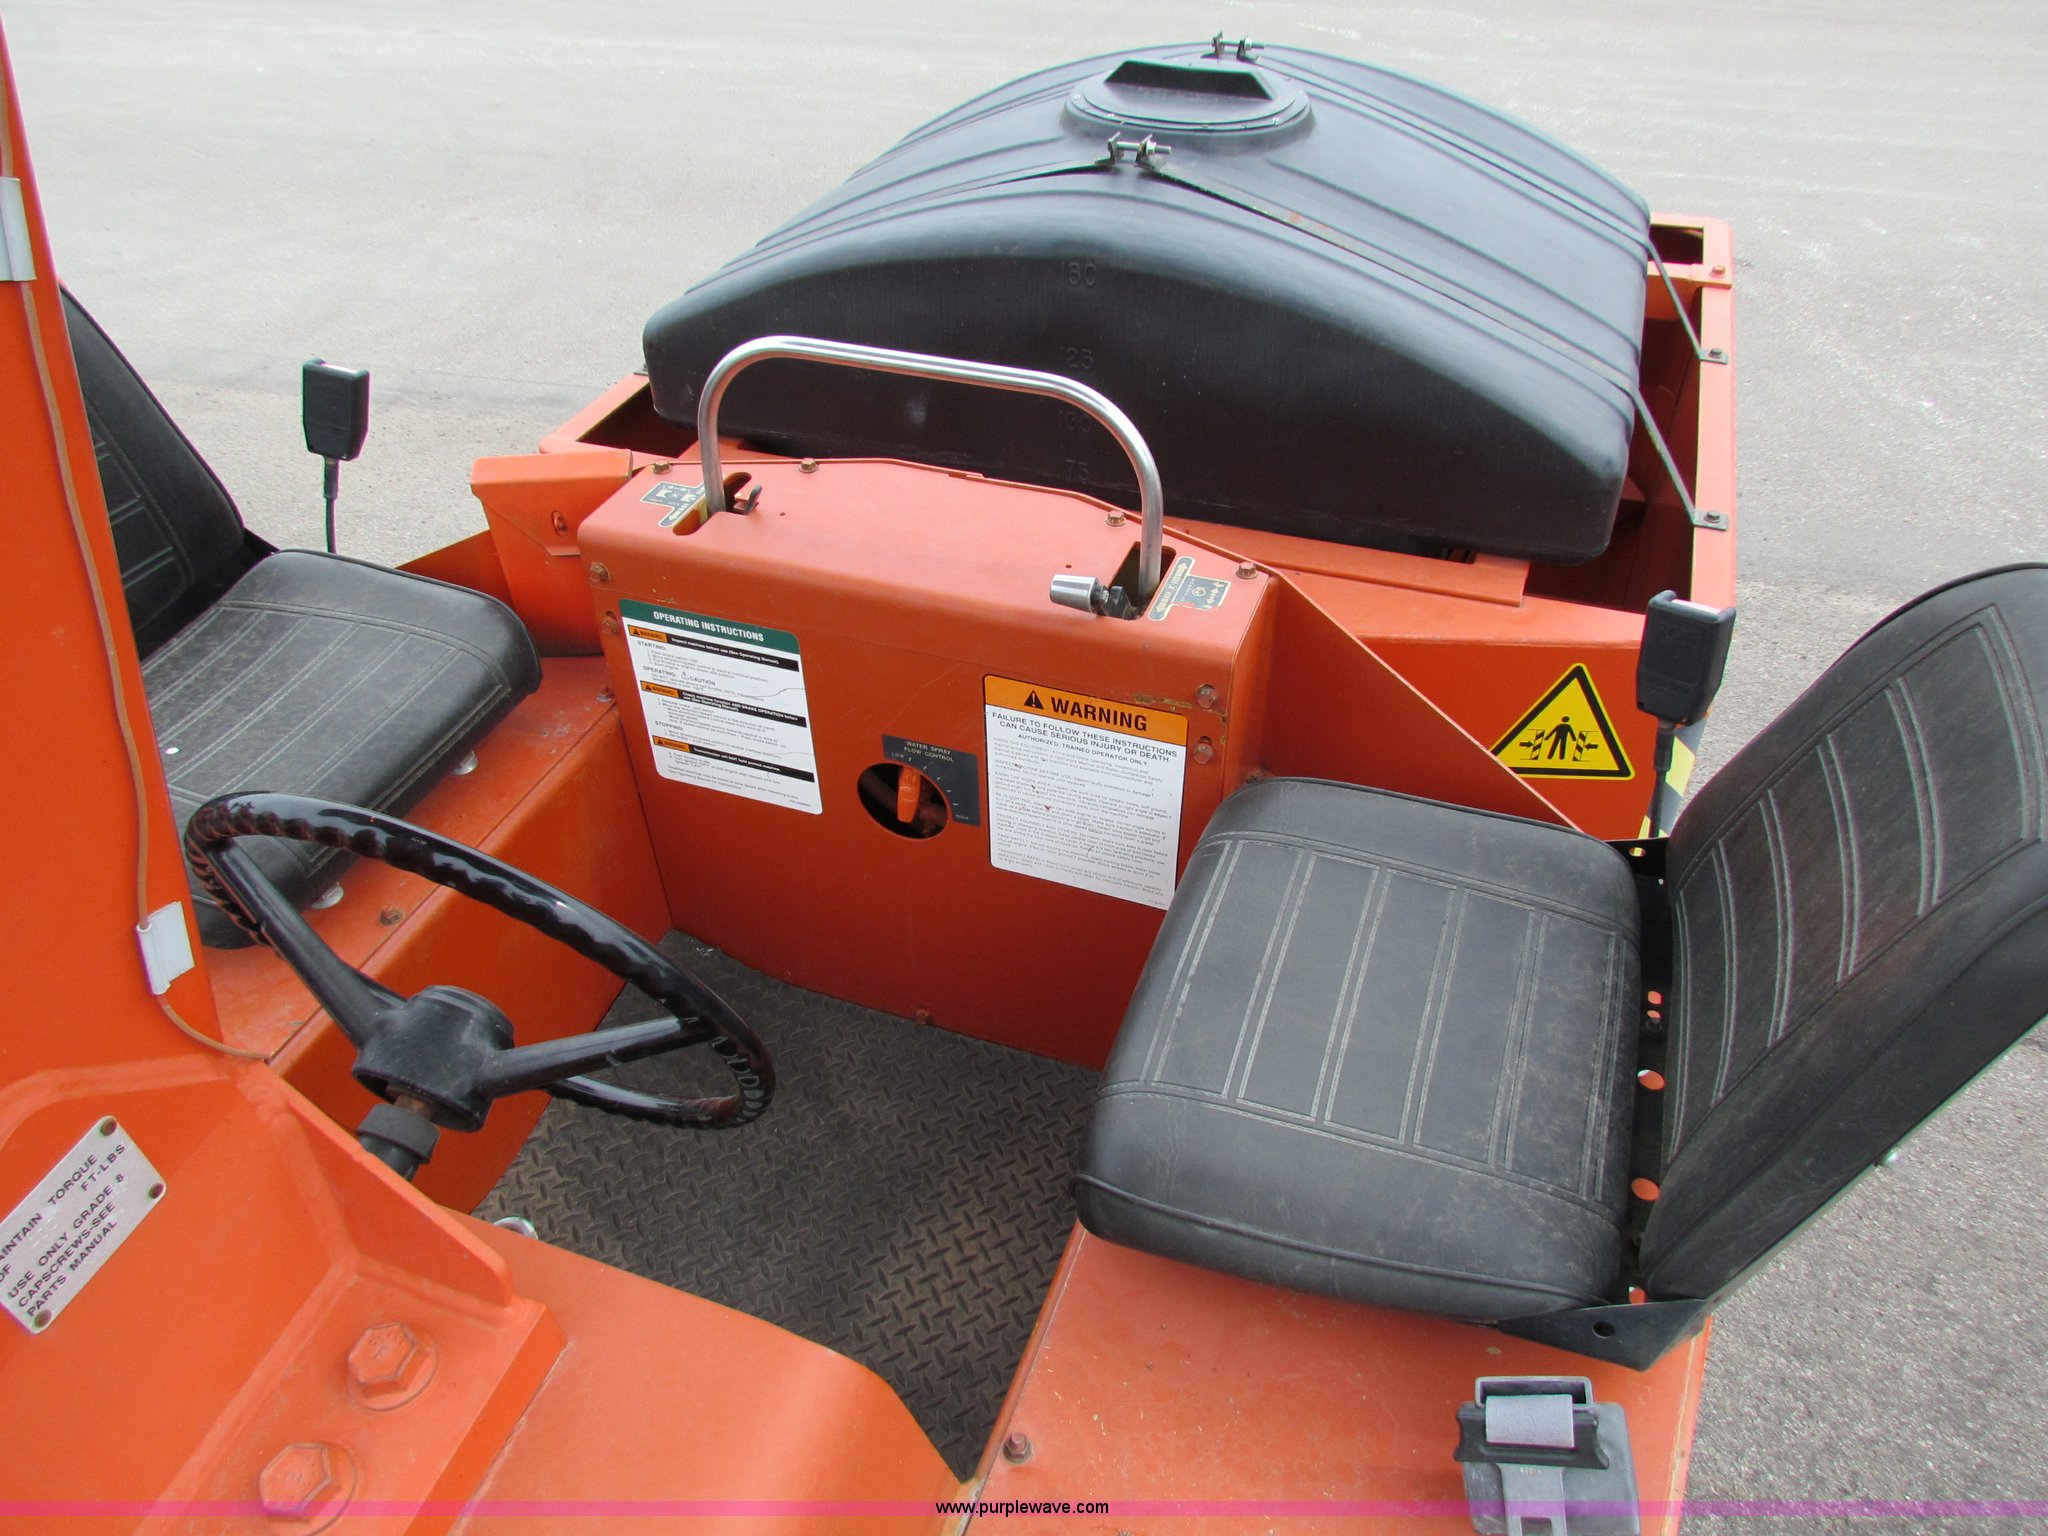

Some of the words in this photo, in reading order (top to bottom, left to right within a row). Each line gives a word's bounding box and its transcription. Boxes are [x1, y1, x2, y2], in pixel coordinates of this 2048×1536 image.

[652, 610, 699, 628] OPERATING
[700, 620, 764, 641] INSTRUCTIONS
[689, 676, 716, 686] CAUTION
[992, 711, 1027, 724] FAILURE
[1030, 719, 1040, 727] TO
[1043, 722, 1079, 735] FOLLOW
[1083, 731, 1109, 742] THESE
[1113, 737, 1177, 756] INSTRUCTIONS
[1051, 696, 1147, 732] WARNING
[904, 746, 921, 755] FLOW
[925, 751, 954, 762] CONTROL
[906, 741, 928, 750] WATER
[931, 746, 951, 755] SPRAY
[999, 720, 1016, 729] CAN
[1019, 724, 1047, 736] CAUSE
[1050, 731, 1087, 745] SERIOUS
[1090, 739, 1121, 752] INJURY
[1124, 747, 1136, 755] OR
[1139, 750, 1169, 762] DEATH
[1062, 742, 1089, 753] TRAINED
[1091, 749, 1127, 761] OPERATOR
[1129, 757, 1147, 766] ONLY
[81, 1143, 126, 1192] FT-LBS
[0, 1213, 42, 1262] AINTAIN
[48, 1154, 98, 1206] TORQUE
[8, 1270, 36, 1298] USE
[38, 1231, 69, 1267] ONLY
[72, 1185, 113, 1229] GRADE
[116, 1173, 125, 1183] 8
[18, 1201, 116, 1307] CAPSCREWS-SEE
[27, 1274, 67, 1317] PARTS
[69, 1220, 118, 1272] MANUAL
